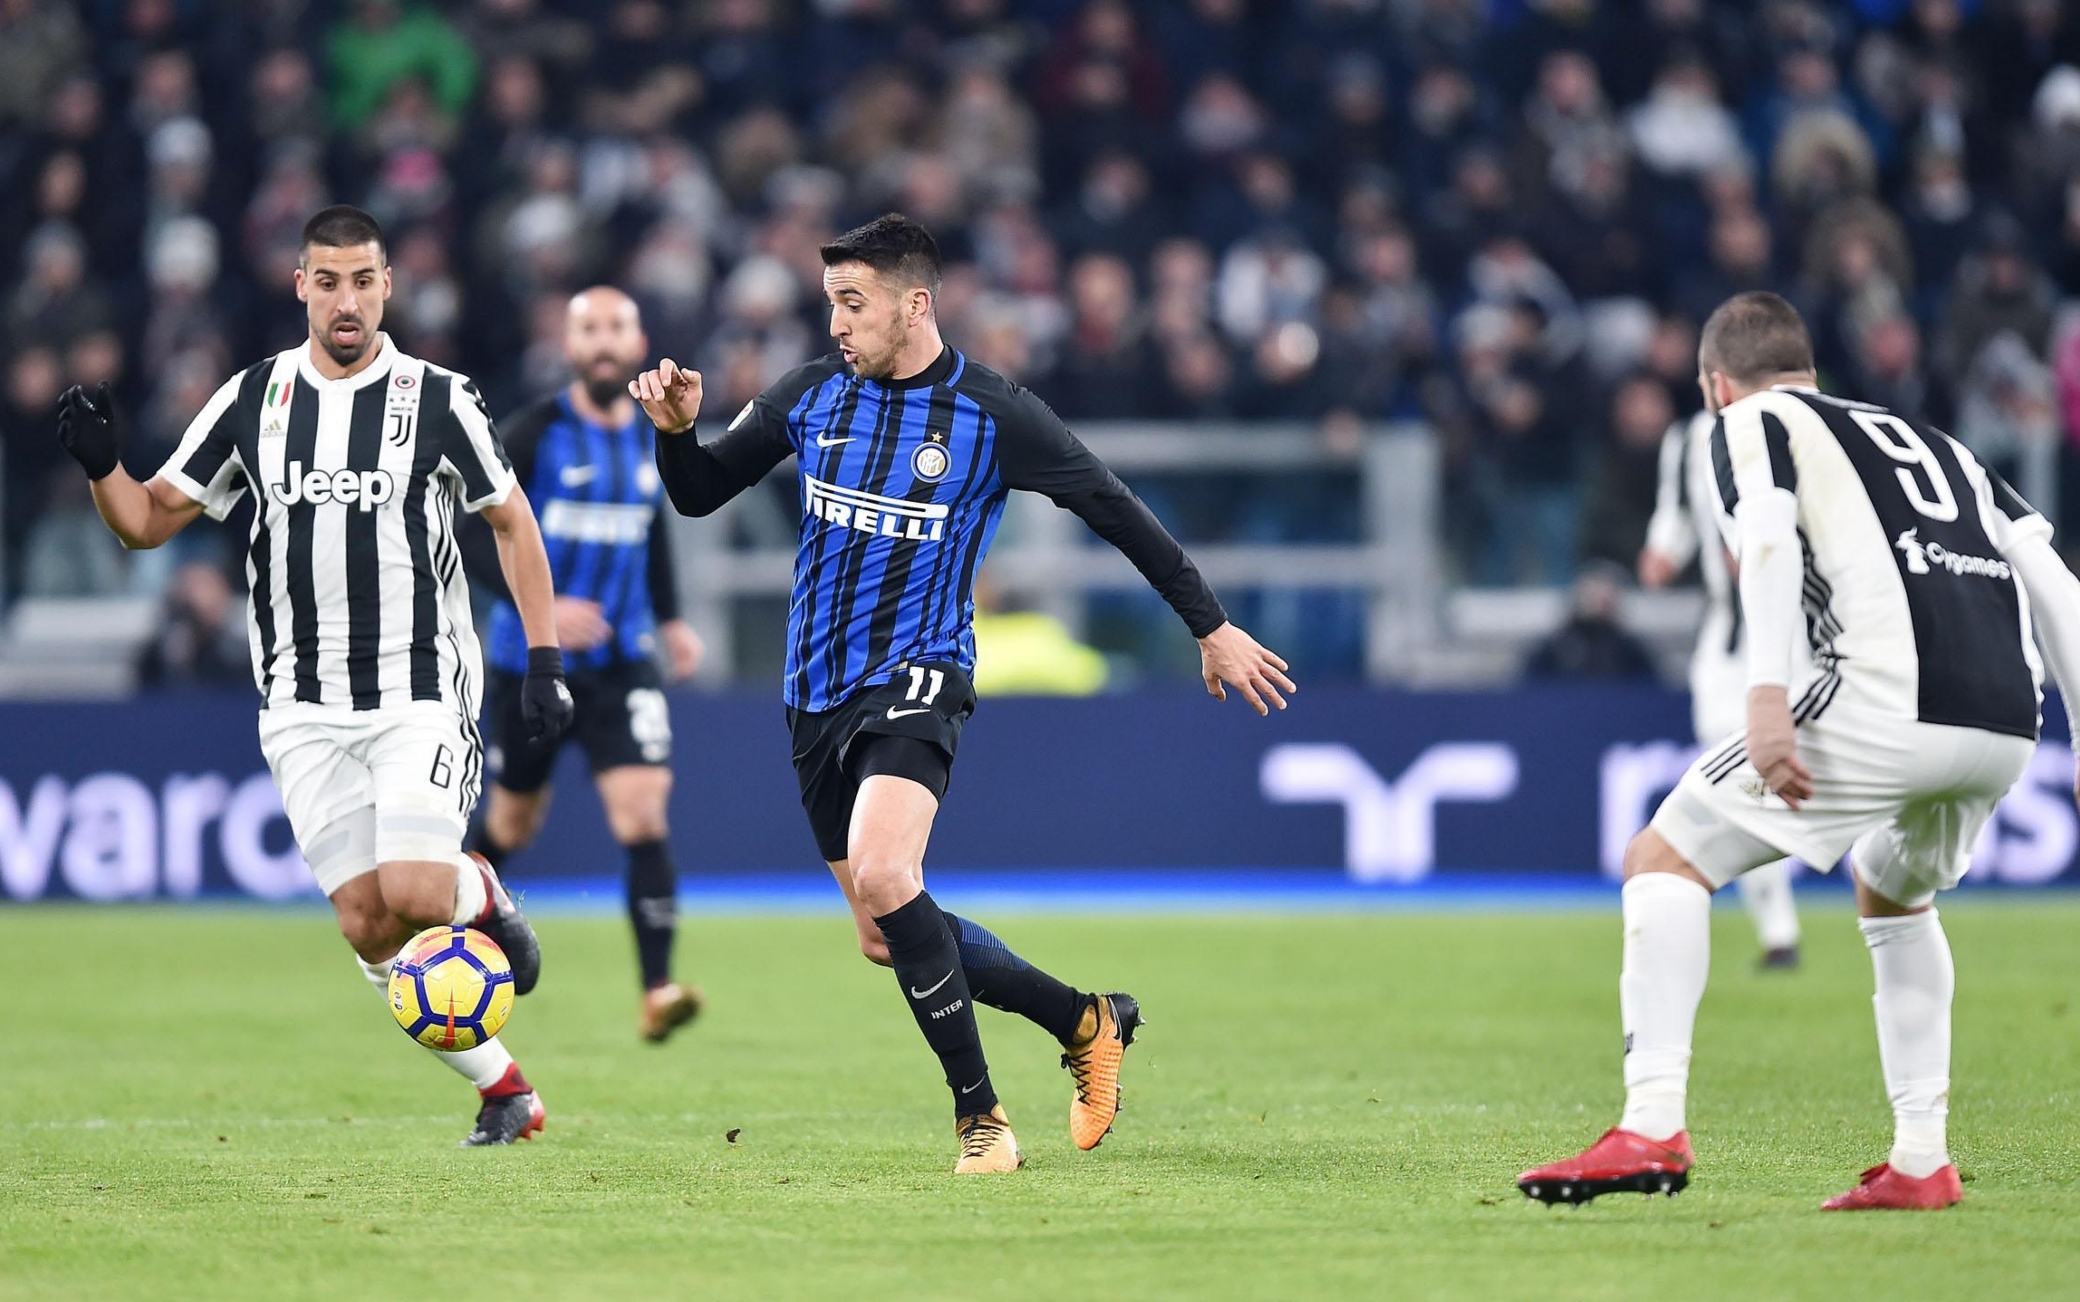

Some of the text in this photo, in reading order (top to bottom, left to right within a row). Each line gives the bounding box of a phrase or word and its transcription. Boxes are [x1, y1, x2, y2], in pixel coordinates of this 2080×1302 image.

[271, 460, 395, 512] Jeep
[1847, 409, 1959, 523] 9
[805, 472, 950, 541] PIRELLI
[1926, 541, 2011, 580] Cygames
[905, 666, 945, 706] 11
[430, 743, 454, 789] 6
[930, 999, 964, 1020] INTER
